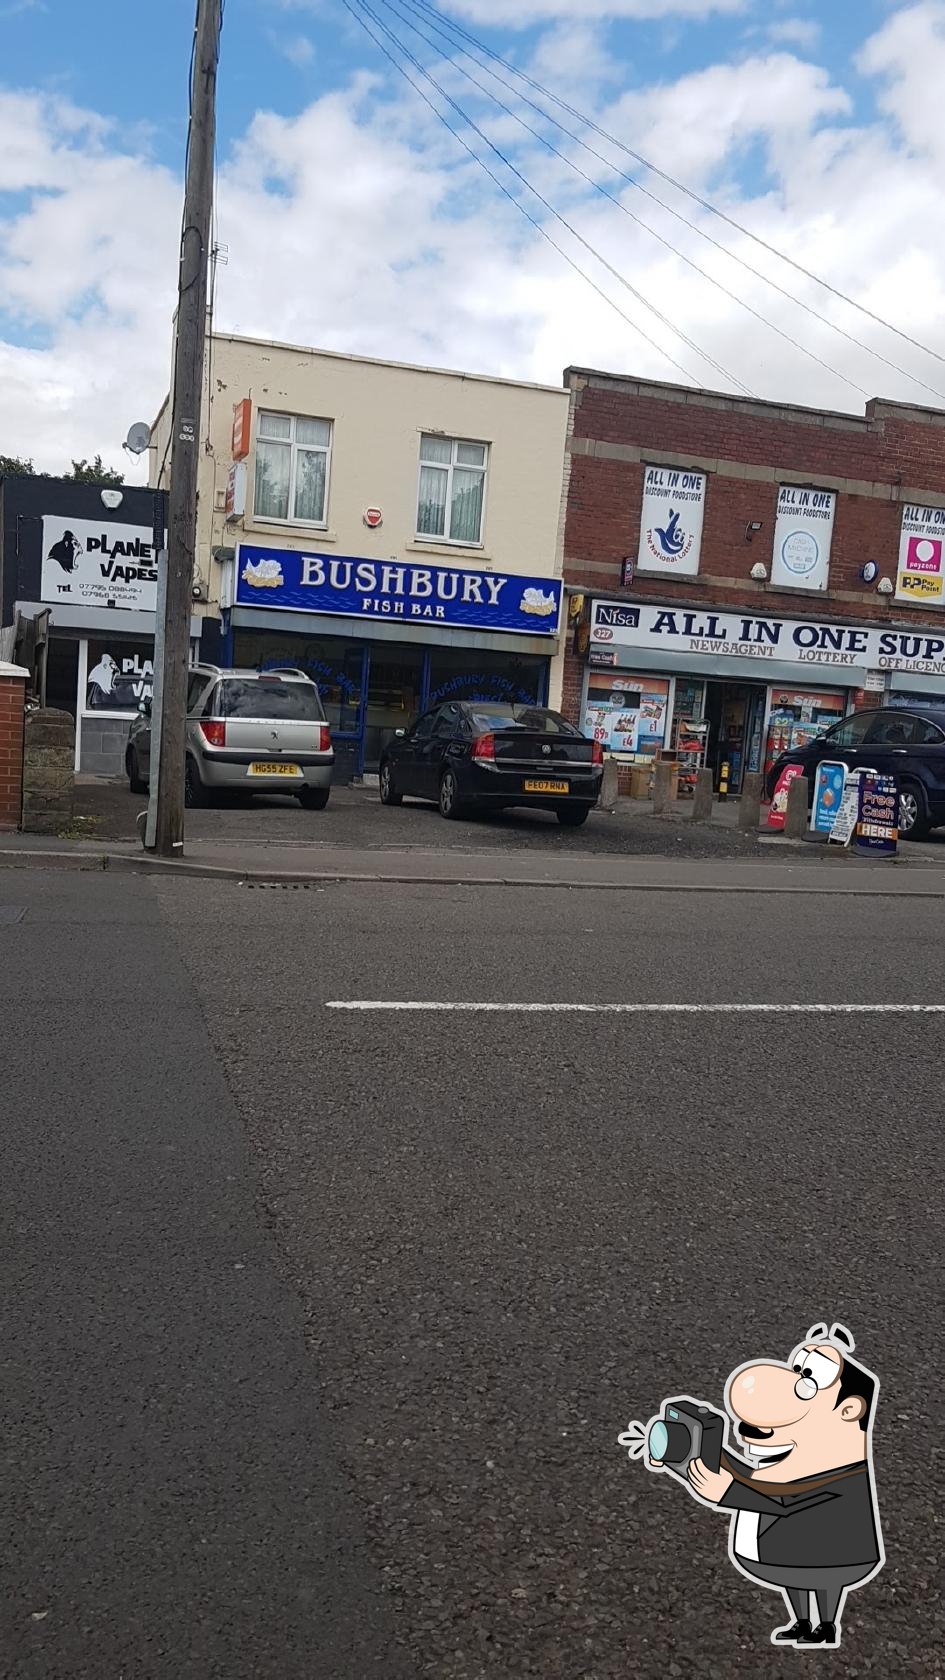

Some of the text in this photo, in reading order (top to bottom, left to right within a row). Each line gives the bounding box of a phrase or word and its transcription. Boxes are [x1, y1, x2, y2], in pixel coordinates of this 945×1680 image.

[646, 469, 702, 490] ALL IN ONE
[645, 486, 702, 502] DISCOUNT FOODSTORE
[779, 488, 831, 508] ALL IN ONE
[778, 505, 831, 520] DISCOUNT FOODSTORE
[904, 506, 919, 521] ALL
[921, 508, 933, 522] IN
[902, 522, 925, 533] DISCOUNT
[649, 542, 677, 563] National
[677, 534, 695, 560] Lottery
[99, 560, 158, 583] VAPES
[909, 561, 937, 570] payzone
[57, 584, 73, 593] TEL
[300, 556, 508, 606] BUSHBURY
[921, 584, 939, 593] Point
[362, 598, 446, 618] FISH BAR
[596, 629, 611, 638] 327
[598, 607, 945, 660] Nisa ALL IN ONE SUP
[689, 639, 775, 657] NEWSAGENT
[798, 648, 858, 664] LOTTERY
[879, 656, 903, 668] OFF
[593, 728, 608, 740] 89p
[623, 735, 633, 747] £4
[255, 764, 295, 774] HG55 ZFE
[863, 791, 895, 807] Free
[862, 805, 894, 820] Cash
[862, 824, 893, 838] HERE
